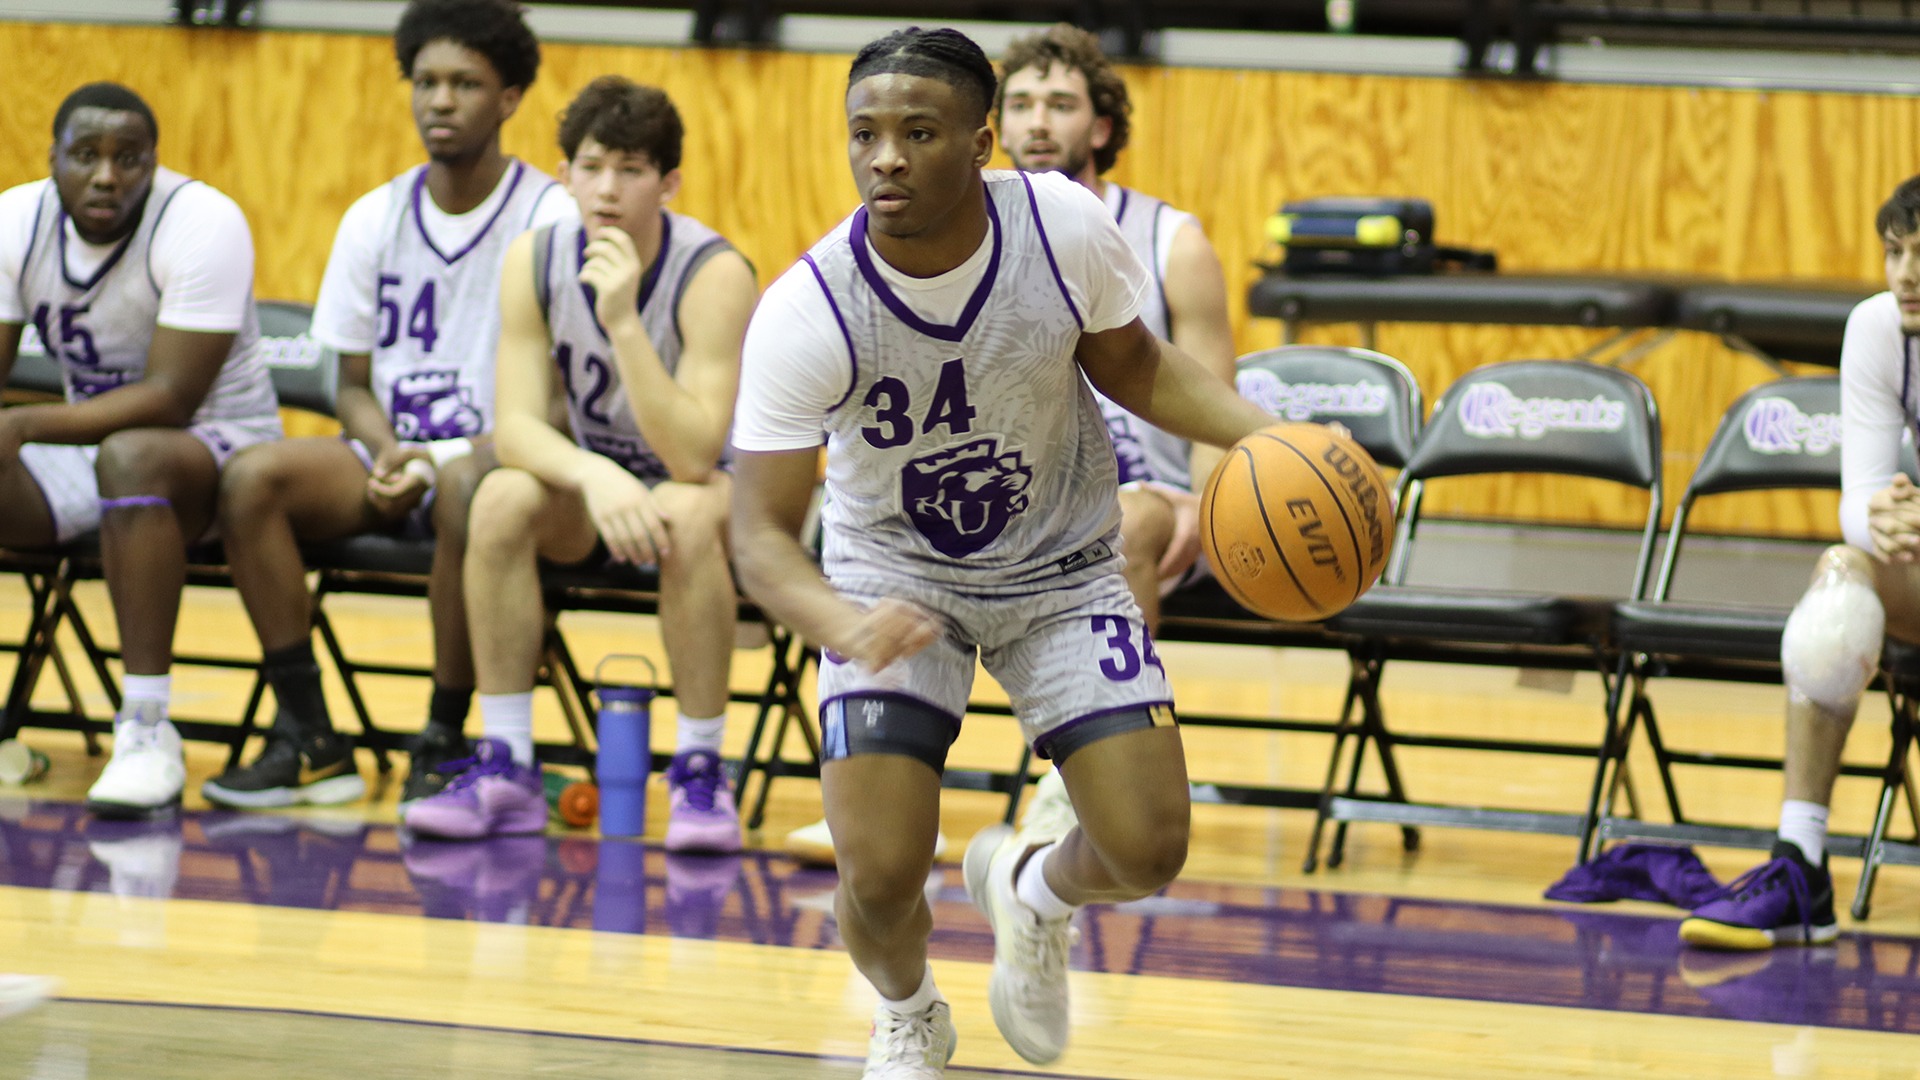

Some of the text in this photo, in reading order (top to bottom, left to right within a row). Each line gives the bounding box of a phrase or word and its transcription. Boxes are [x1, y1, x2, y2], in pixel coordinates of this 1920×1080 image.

[34, 303, 99, 365] 15
[378, 273, 438, 352] 54
[557, 343, 610, 424] 12
[861, 357, 976, 449] 34
[1236, 369, 1389, 420] Regents
[1458, 382, 1626, 438] Regents
[1286, 498, 1338, 567] EVO
